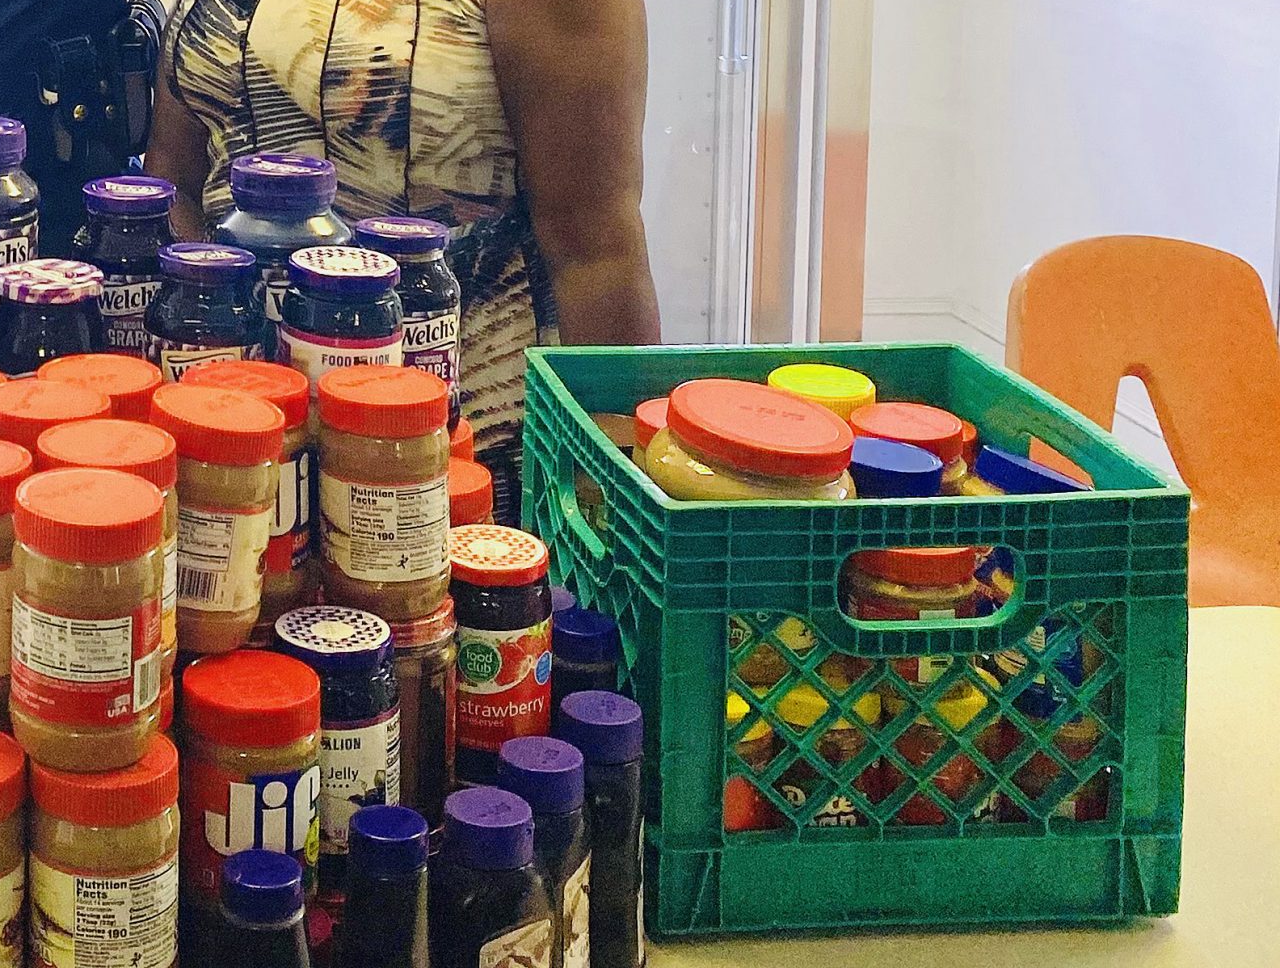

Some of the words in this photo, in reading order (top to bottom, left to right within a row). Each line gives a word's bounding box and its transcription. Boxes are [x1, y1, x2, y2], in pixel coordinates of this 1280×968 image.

[100, 285, 157, 310] Welch'
[322, 353, 352, 367] FOOD
[351, 485, 394, 498] Nutrition
[351, 495, 378, 505] Facts
[466, 649, 493, 663] food
[467, 660, 492, 673] club
[460, 695, 545, 718] strawberry
[333, 737, 361, 751] LION
[328, 766, 359, 782] Jelly
[204, 765, 320, 856] Jif
[76, 878, 128, 890] Nutrition
[76, 888, 108, 899] Facts
[108, 928, 128, 939] 190
